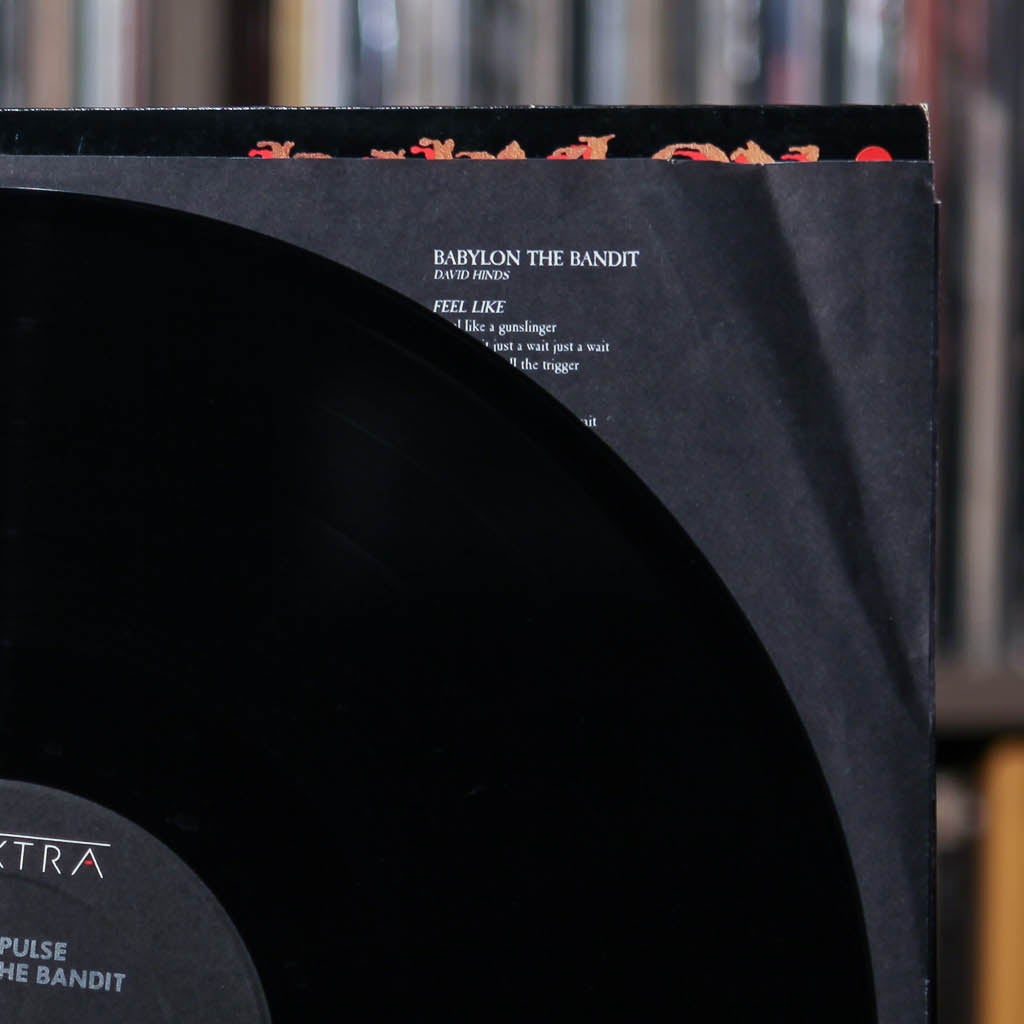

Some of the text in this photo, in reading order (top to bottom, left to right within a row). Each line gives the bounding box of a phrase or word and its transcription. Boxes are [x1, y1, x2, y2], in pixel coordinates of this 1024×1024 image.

[433, 249, 639, 267] BABYLON THE BANDIT
[433, 270, 510, 280] DAVID HINDS
[433, 300, 506, 314] FEEL LIKE
[465, 320, 485, 332] like
[489, 324, 495, 332] a
[498, 320, 557, 336] gunslinger
[493, 339, 514, 352] just
[517, 343, 523, 351] a
[526, 340, 550, 352] wait
[553, 340, 573, 354] just
[577, 343, 583, 352] a
[587, 341, 610, 352] wait
[521, 359, 538, 370] the
[543, 360, 579, 374] trigger
[582, 416, 597, 427] ait
[0, 936, 67, 961] PULSE
[36, 965, 126, 993] BANDIT
